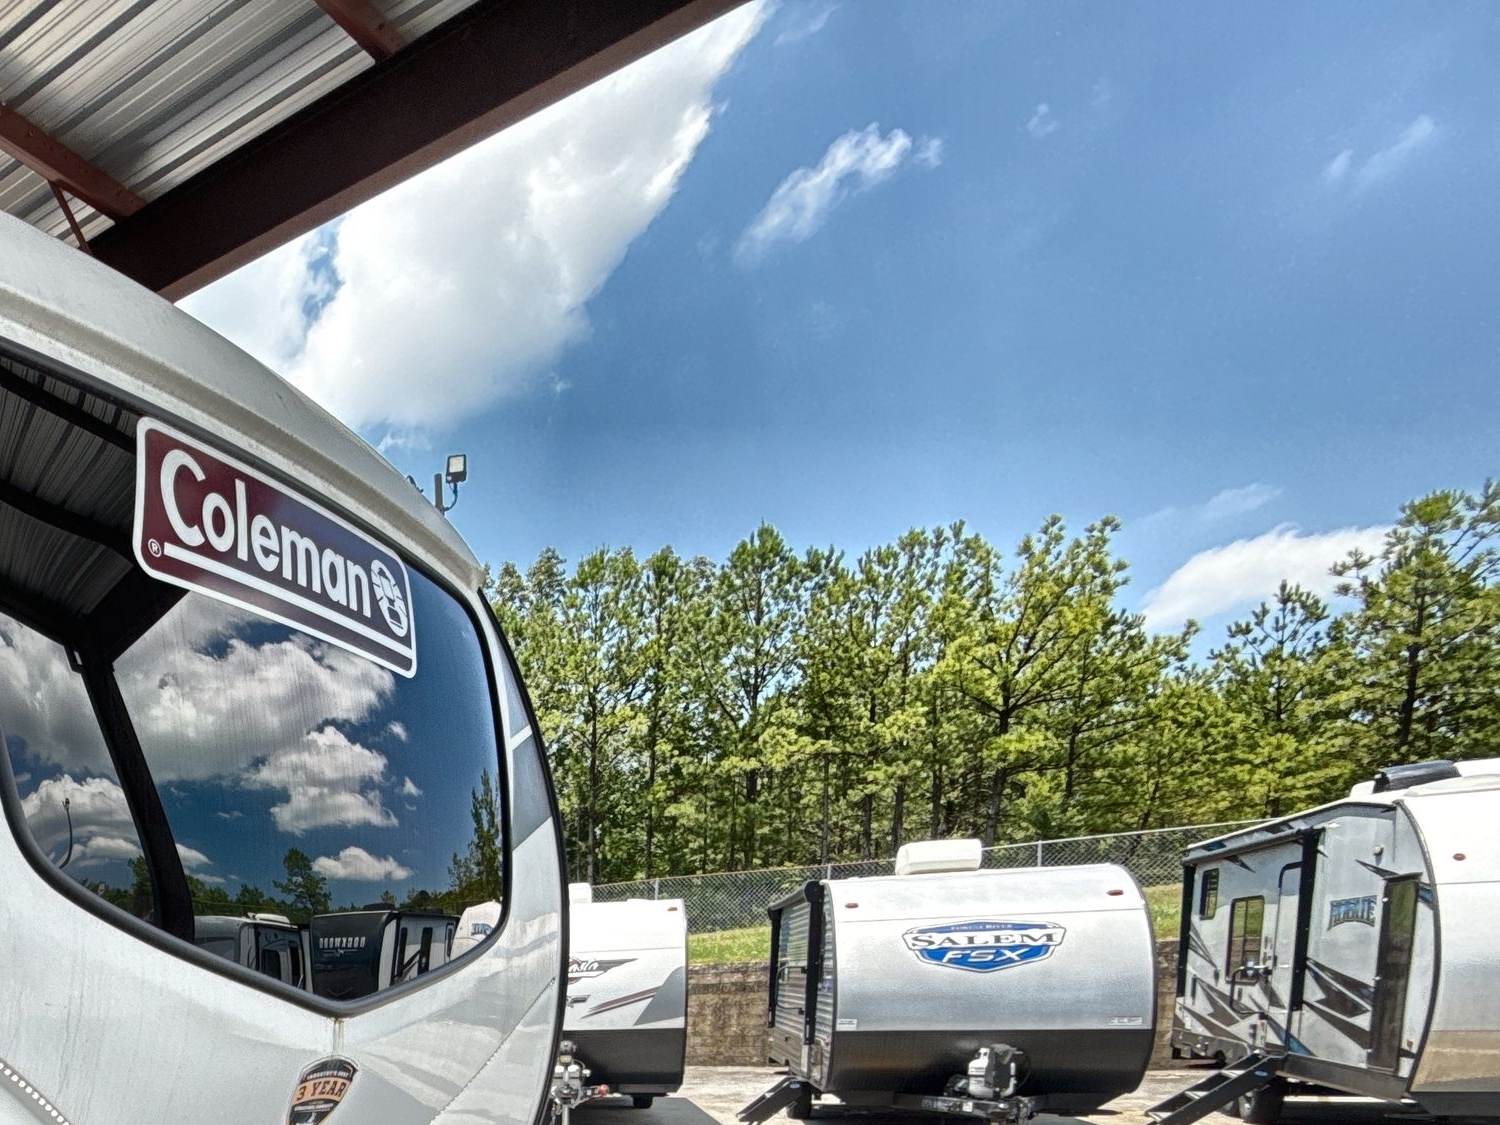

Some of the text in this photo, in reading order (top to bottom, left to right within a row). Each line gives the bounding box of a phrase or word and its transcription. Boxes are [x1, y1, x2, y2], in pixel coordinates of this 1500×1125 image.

[160, 449, 372, 618] Coleman
[911, 933, 1058, 947] SALEM
[942, 948, 1031, 963] FSX
[296, 1080, 347, 1101] 3 YEAR
